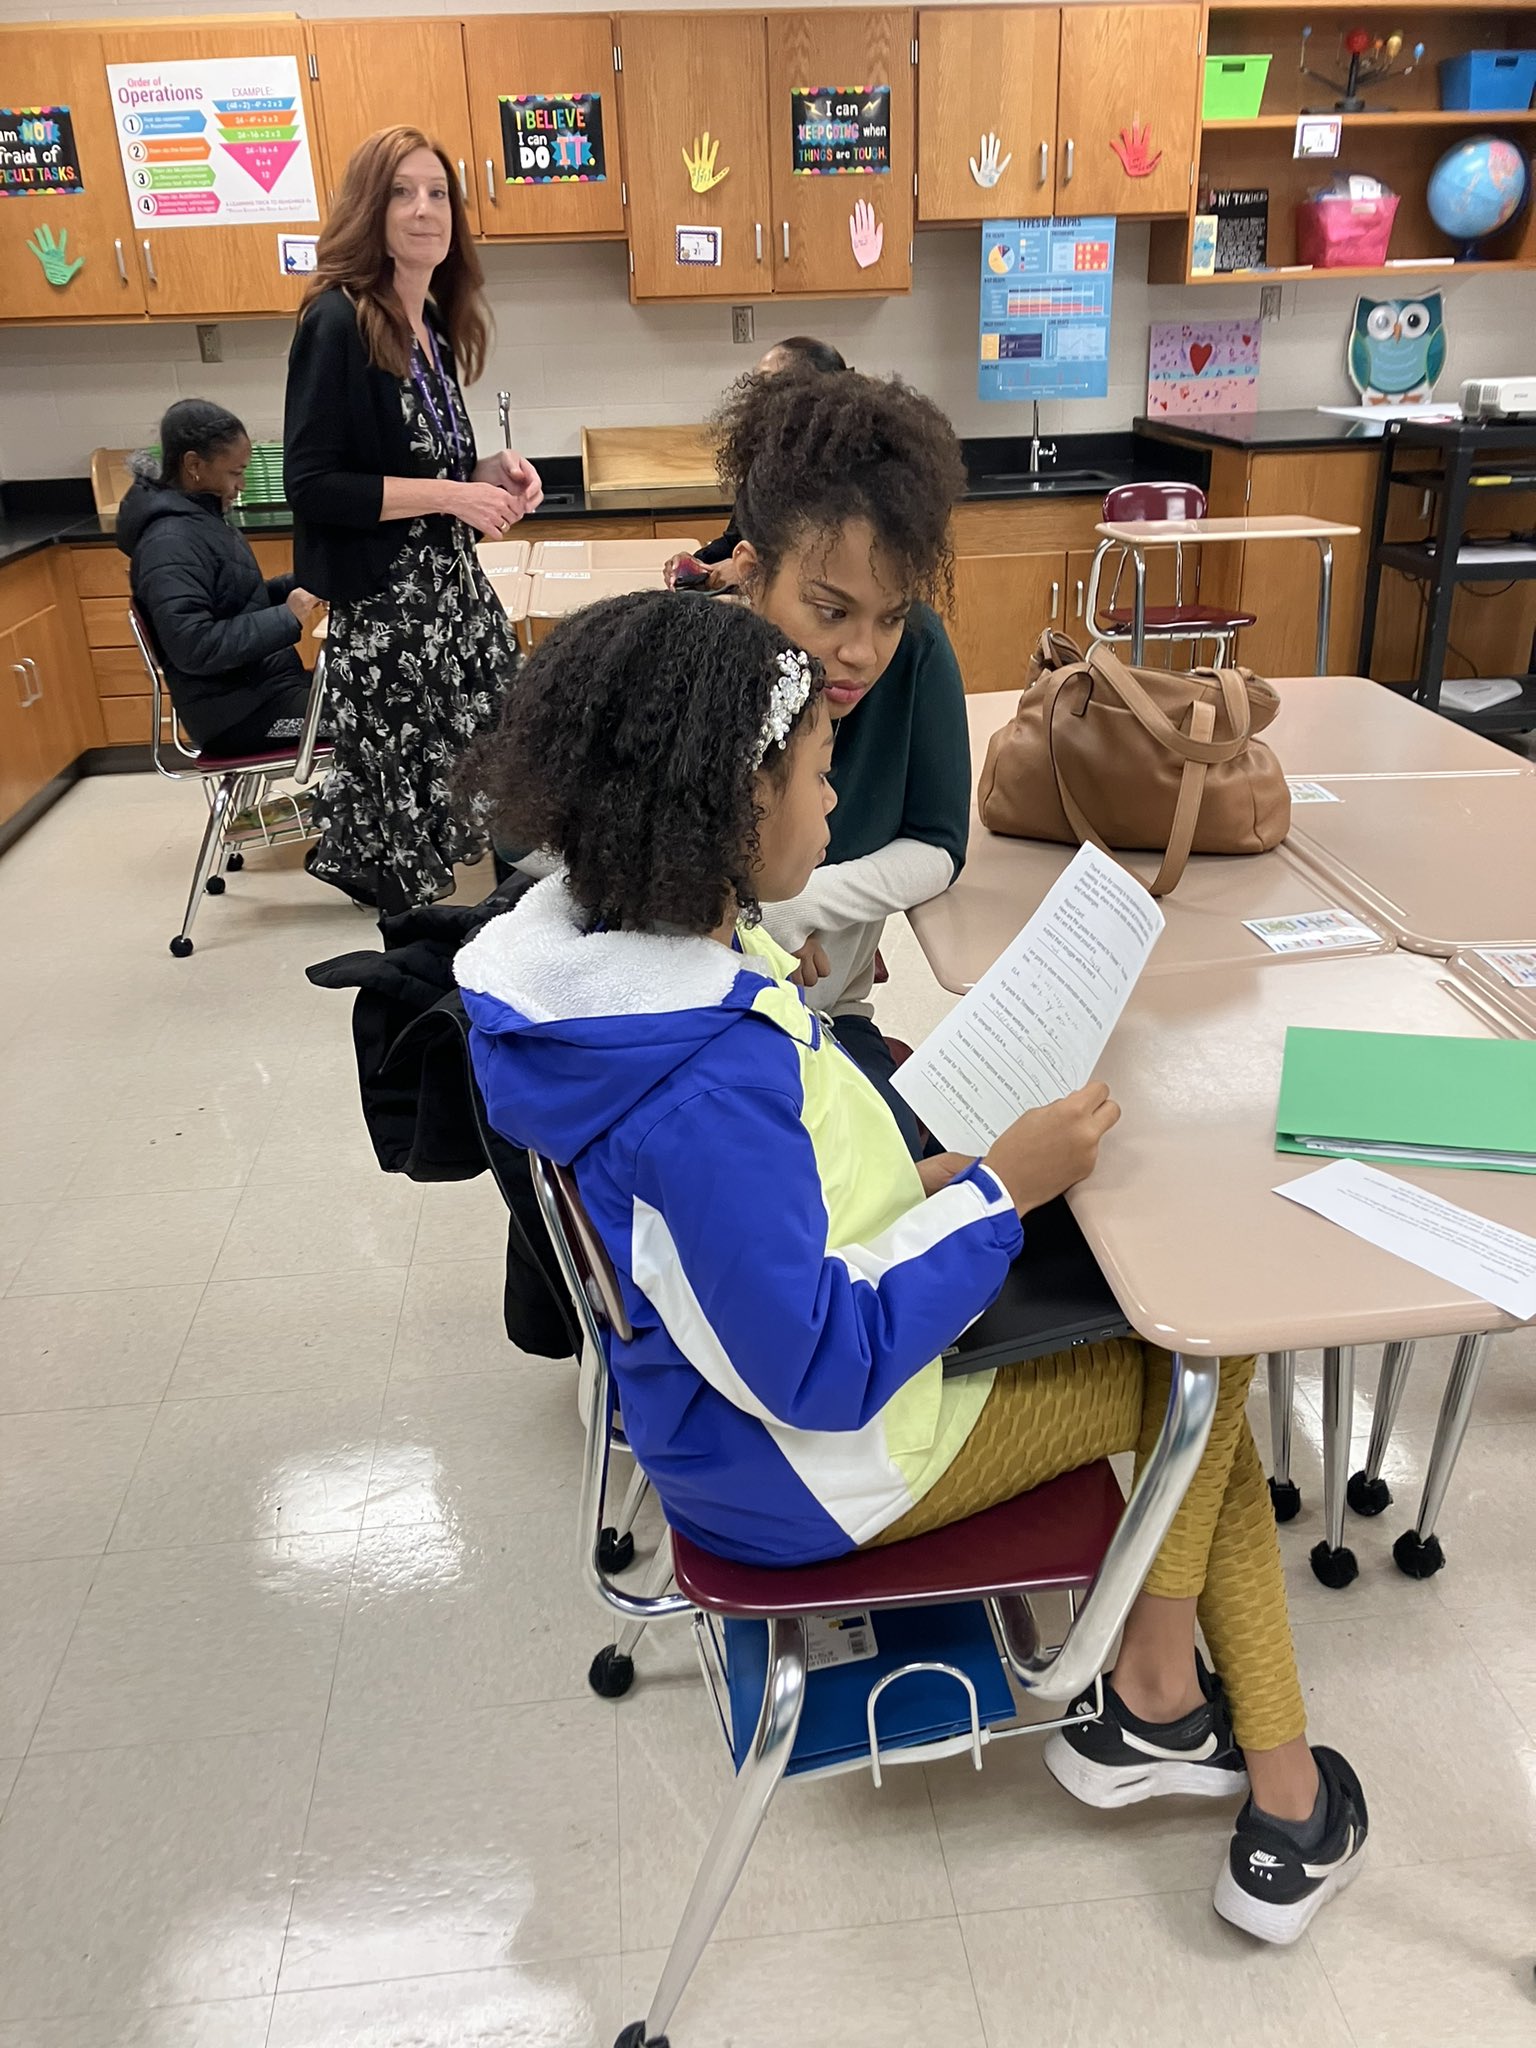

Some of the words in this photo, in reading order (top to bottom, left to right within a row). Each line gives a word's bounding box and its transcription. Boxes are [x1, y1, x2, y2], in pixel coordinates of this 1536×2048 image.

[128, 77, 150, 88] Order
[118, 84, 204, 108] Operations
[826, 100, 833, 117] I
[836, 104, 859, 116] can
[129, 119, 134, 131] 1
[516, 111, 521, 130] I
[526, 108, 586, 130] BELIEVE
[22, 121, 53, 143] NOT
[518, 132, 524, 145] I
[528, 135, 547, 145] can
[799, 124, 824, 141] KEEP
[863, 122, 887, 137] when
[0, 145, 37, 165] fraid
[42, 144, 61, 163] of
[133, 145, 140, 158] 2
[520, 146, 550, 169] DO
[800, 148, 833, 162] THINGS
[836, 151, 851, 160] are
[138, 173, 145, 185] 3
[144, 199, 150, 211] 4
[1253, 1849, 1277, 1863] NIKE
[1249, 1866, 1273, 1881] AIR
